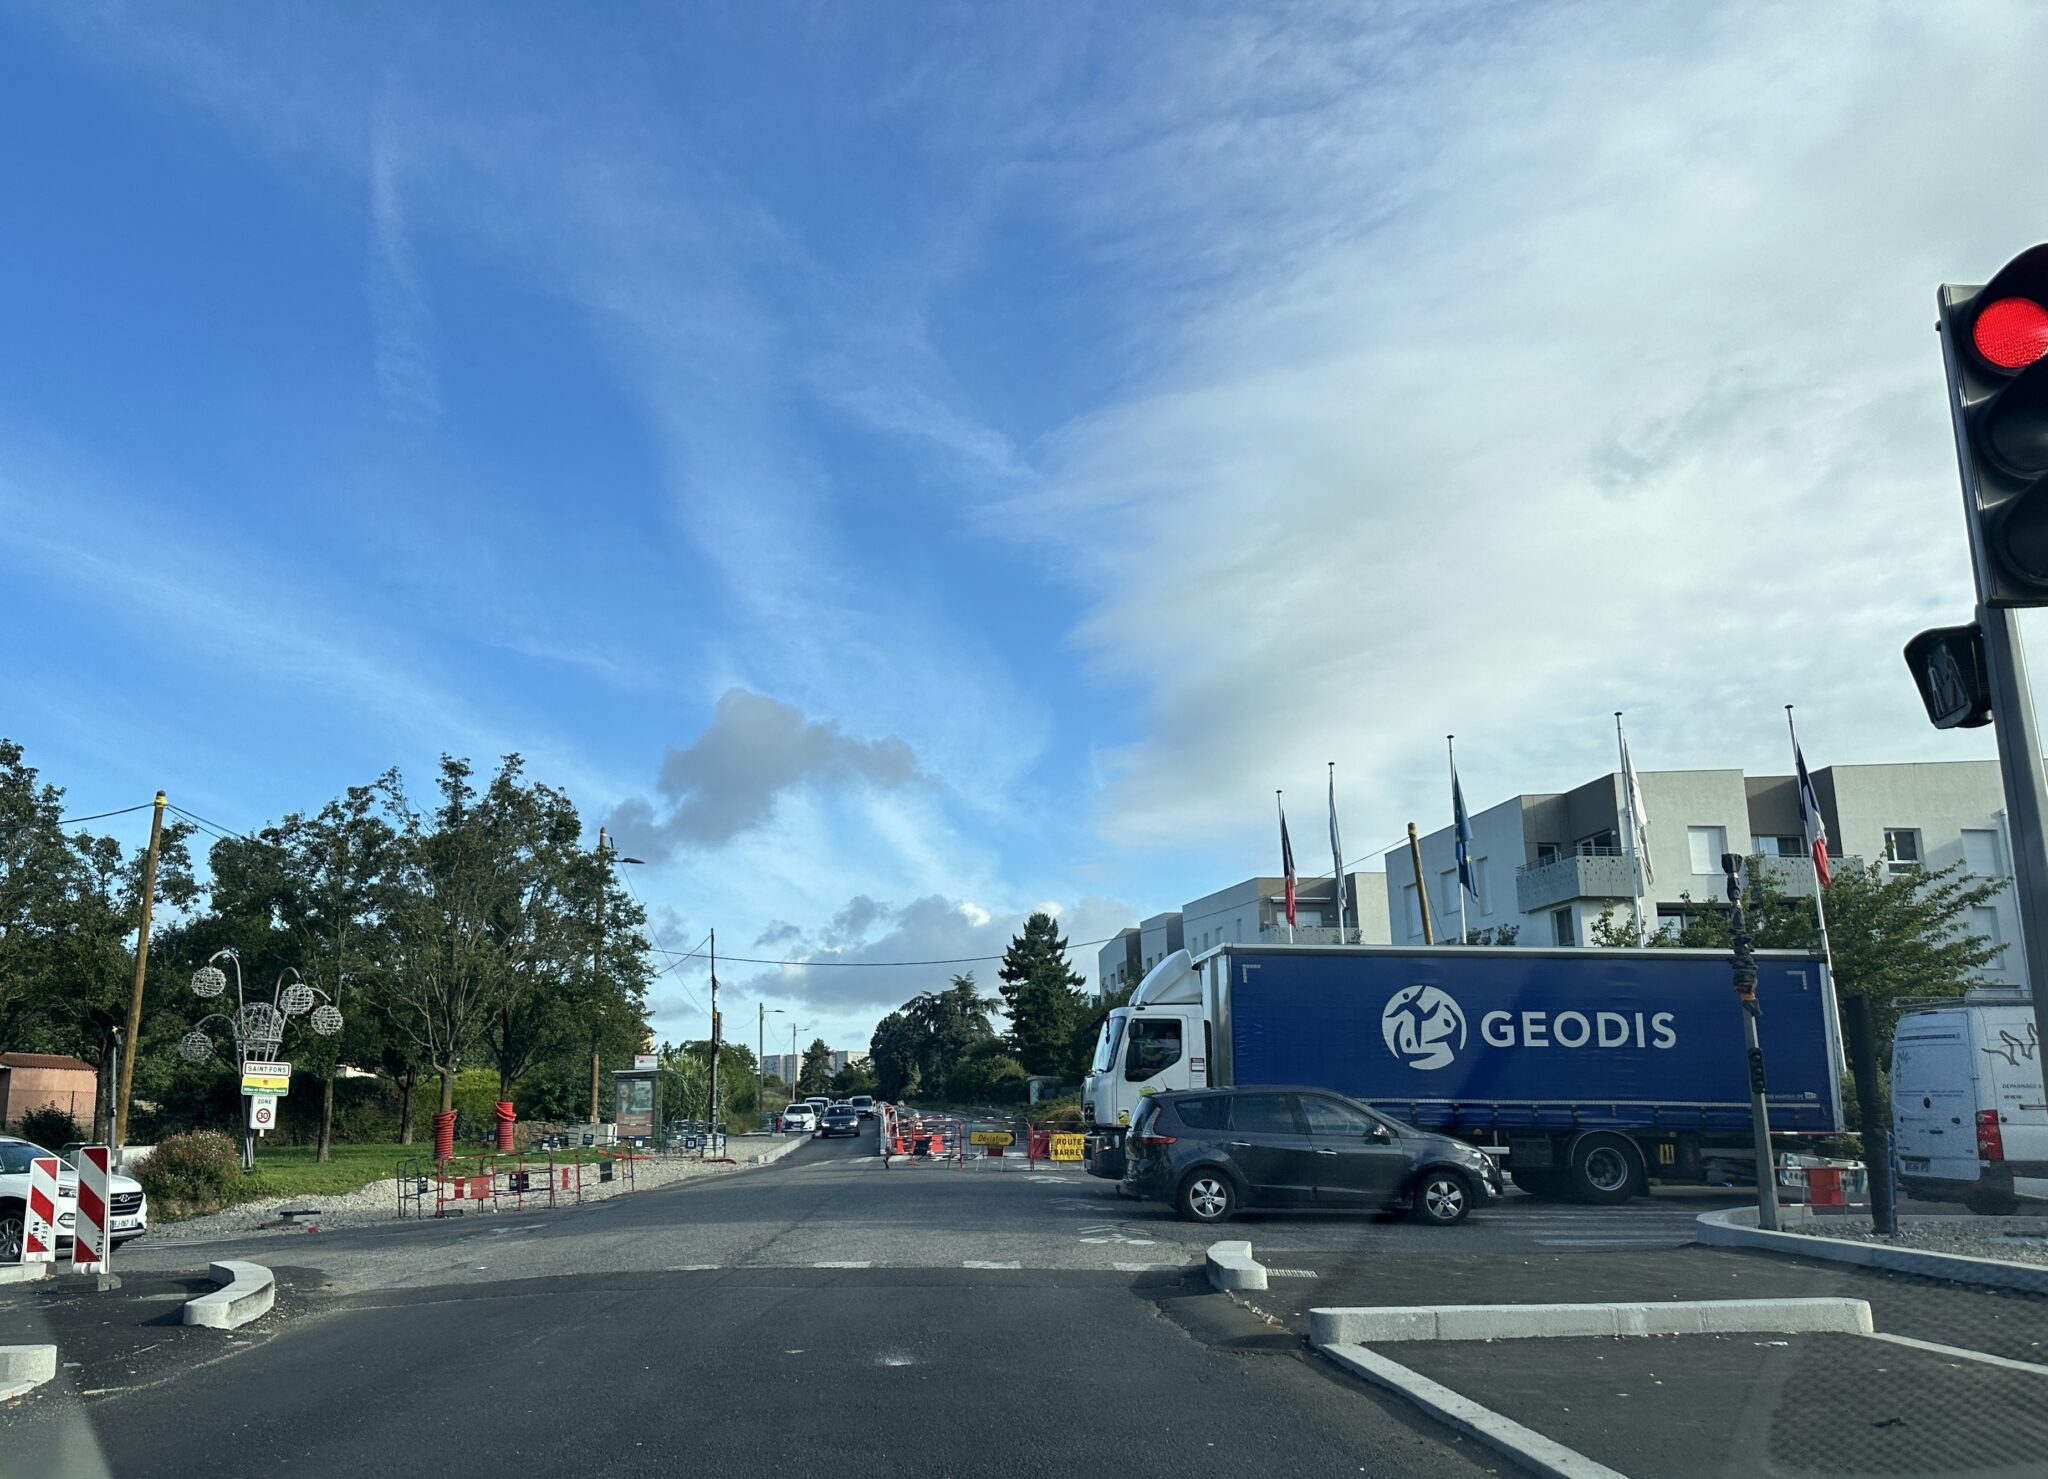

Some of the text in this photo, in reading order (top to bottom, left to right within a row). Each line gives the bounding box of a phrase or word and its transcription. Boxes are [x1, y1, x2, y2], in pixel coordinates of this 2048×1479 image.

[1481, 1010, 1677, 1049] GEODIS
[258, 1112, 269, 1120] 30
[1056, 1138, 1082, 1146] ROUTE
